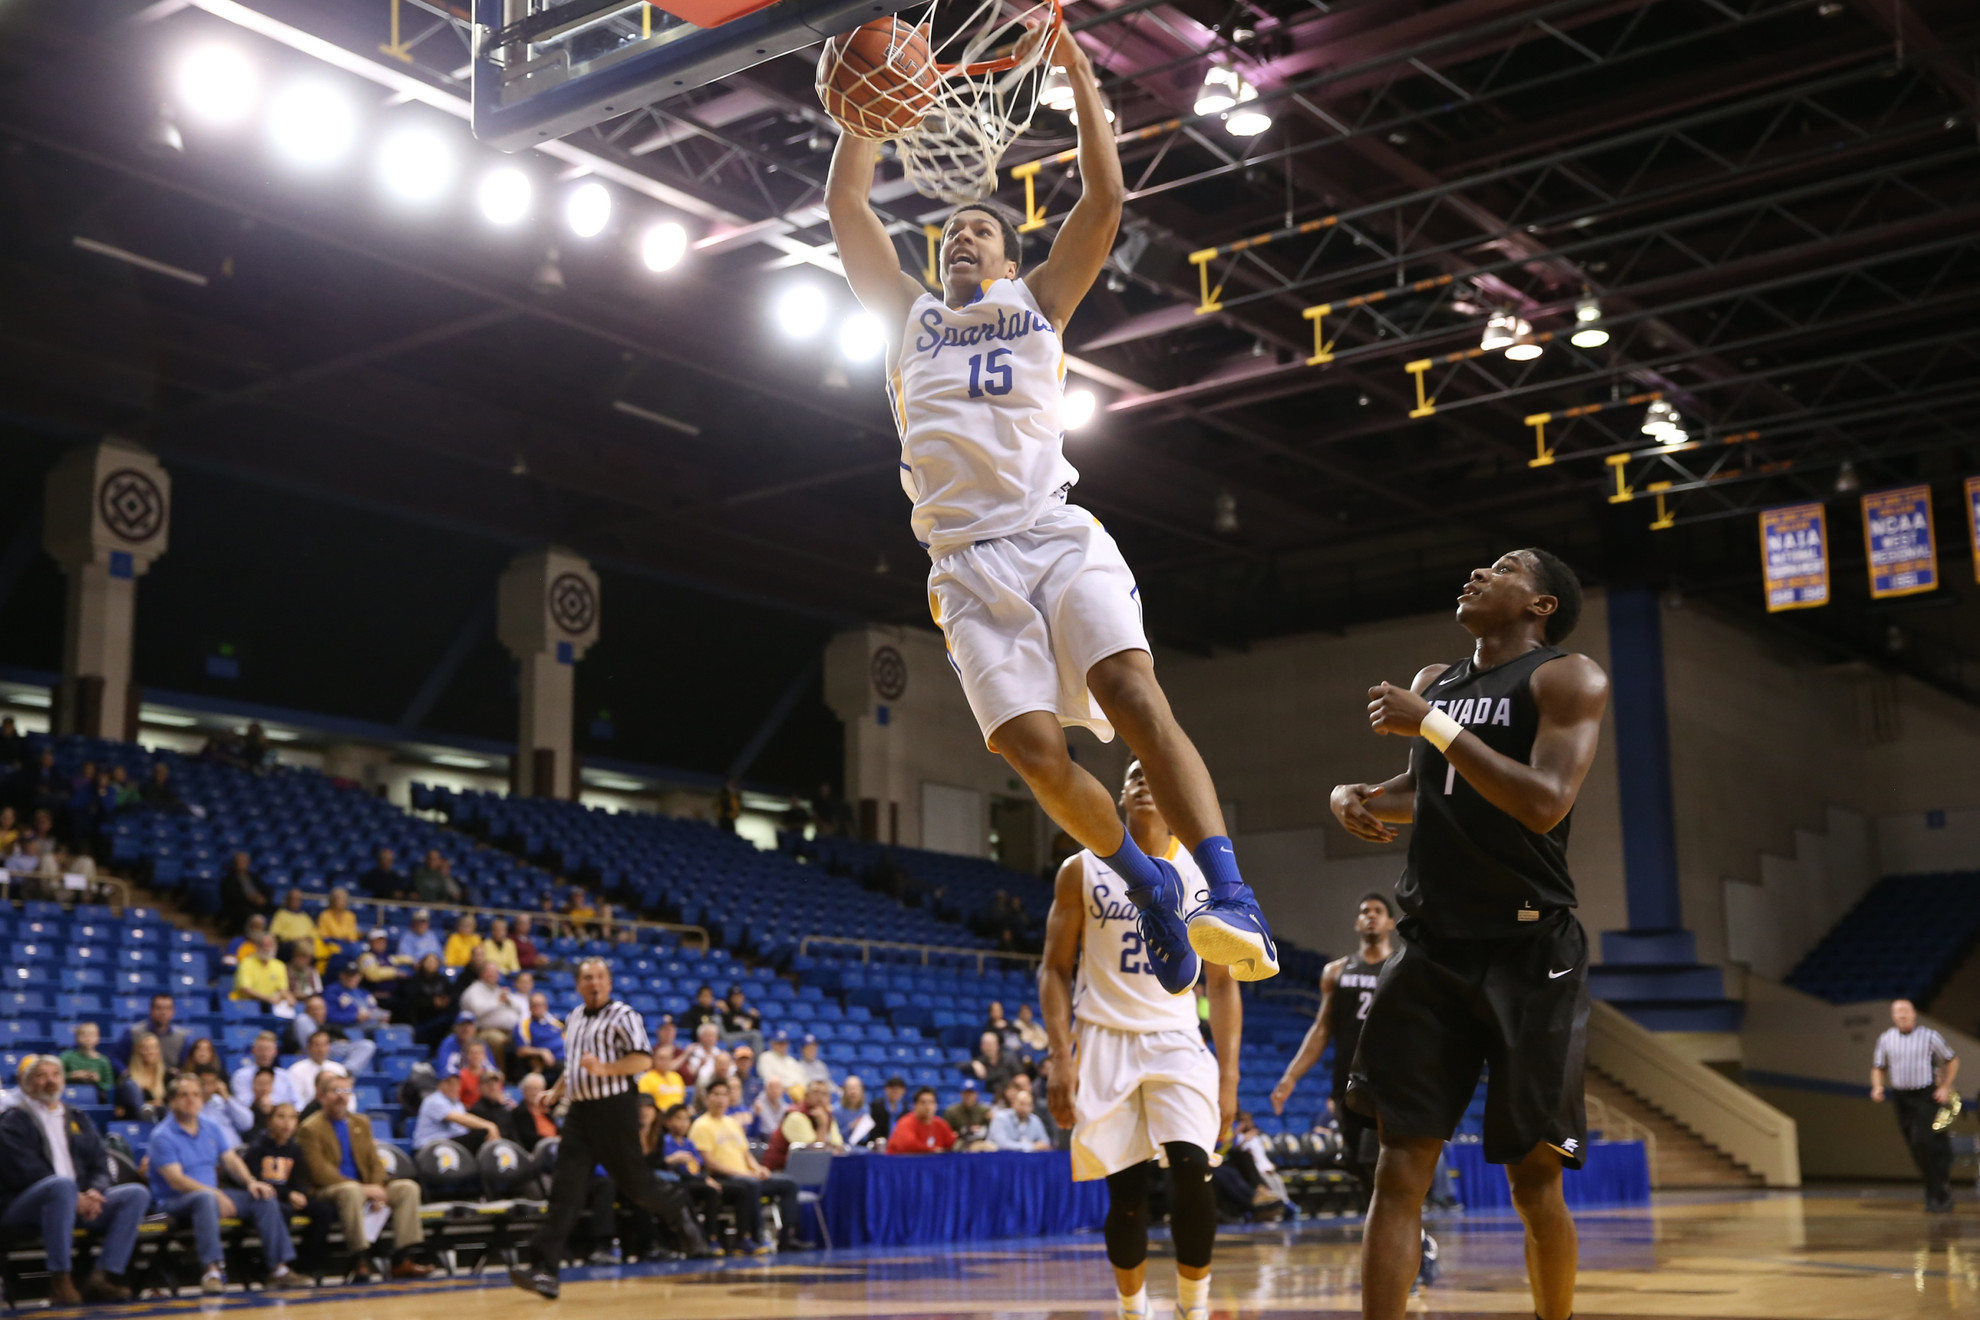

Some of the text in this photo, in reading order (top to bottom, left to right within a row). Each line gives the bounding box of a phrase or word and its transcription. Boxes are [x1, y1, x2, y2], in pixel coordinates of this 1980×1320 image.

[968, 347, 1013, 398] 15
[1870, 512, 1926, 535] NCAA
[1767, 528, 1820, 551] NAIA
[1427, 697, 1510, 726] VADA
[1089, 884, 1141, 929] Spa
[1119, 931, 1157, 976] 2
[1356, 991, 1373, 1019] 2
